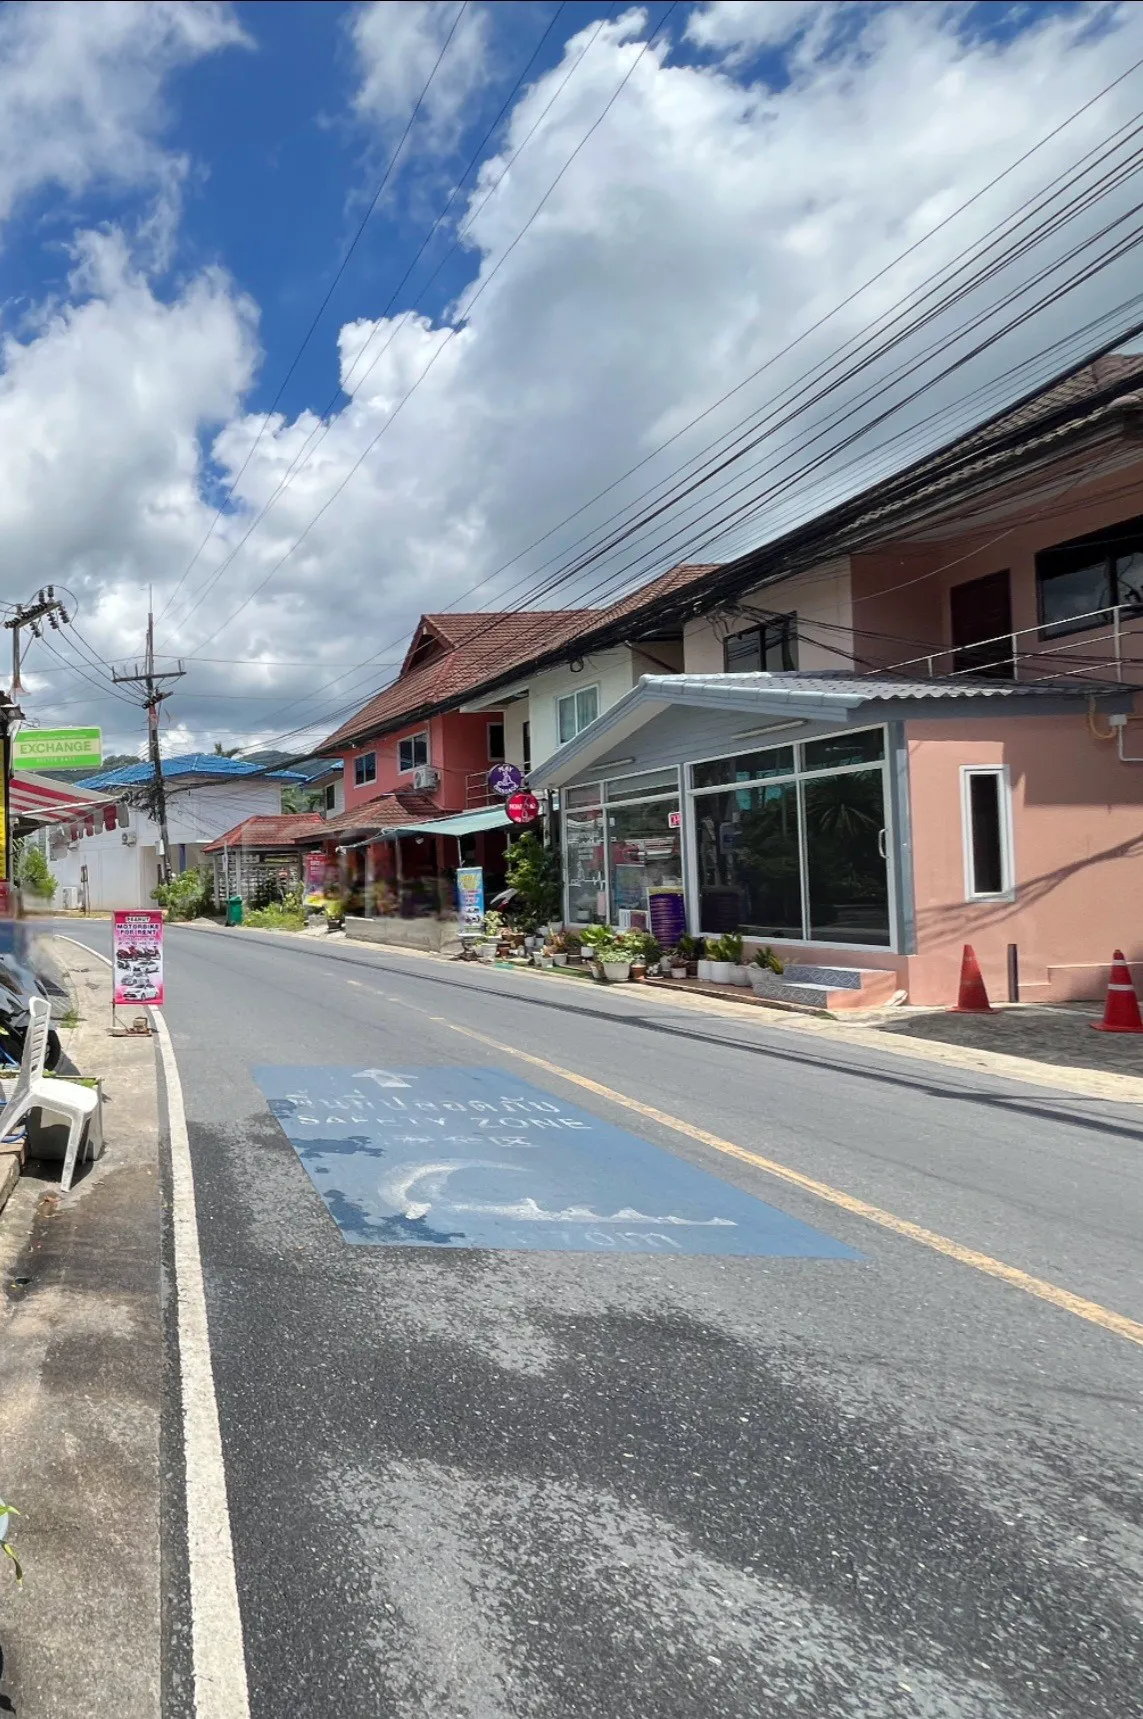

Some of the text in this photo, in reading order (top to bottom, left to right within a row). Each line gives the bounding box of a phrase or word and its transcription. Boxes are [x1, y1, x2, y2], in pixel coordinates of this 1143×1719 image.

[20, 741, 91, 754] EXCHANGE
[296, 1114, 592, 1129] SAFETY ZONE
